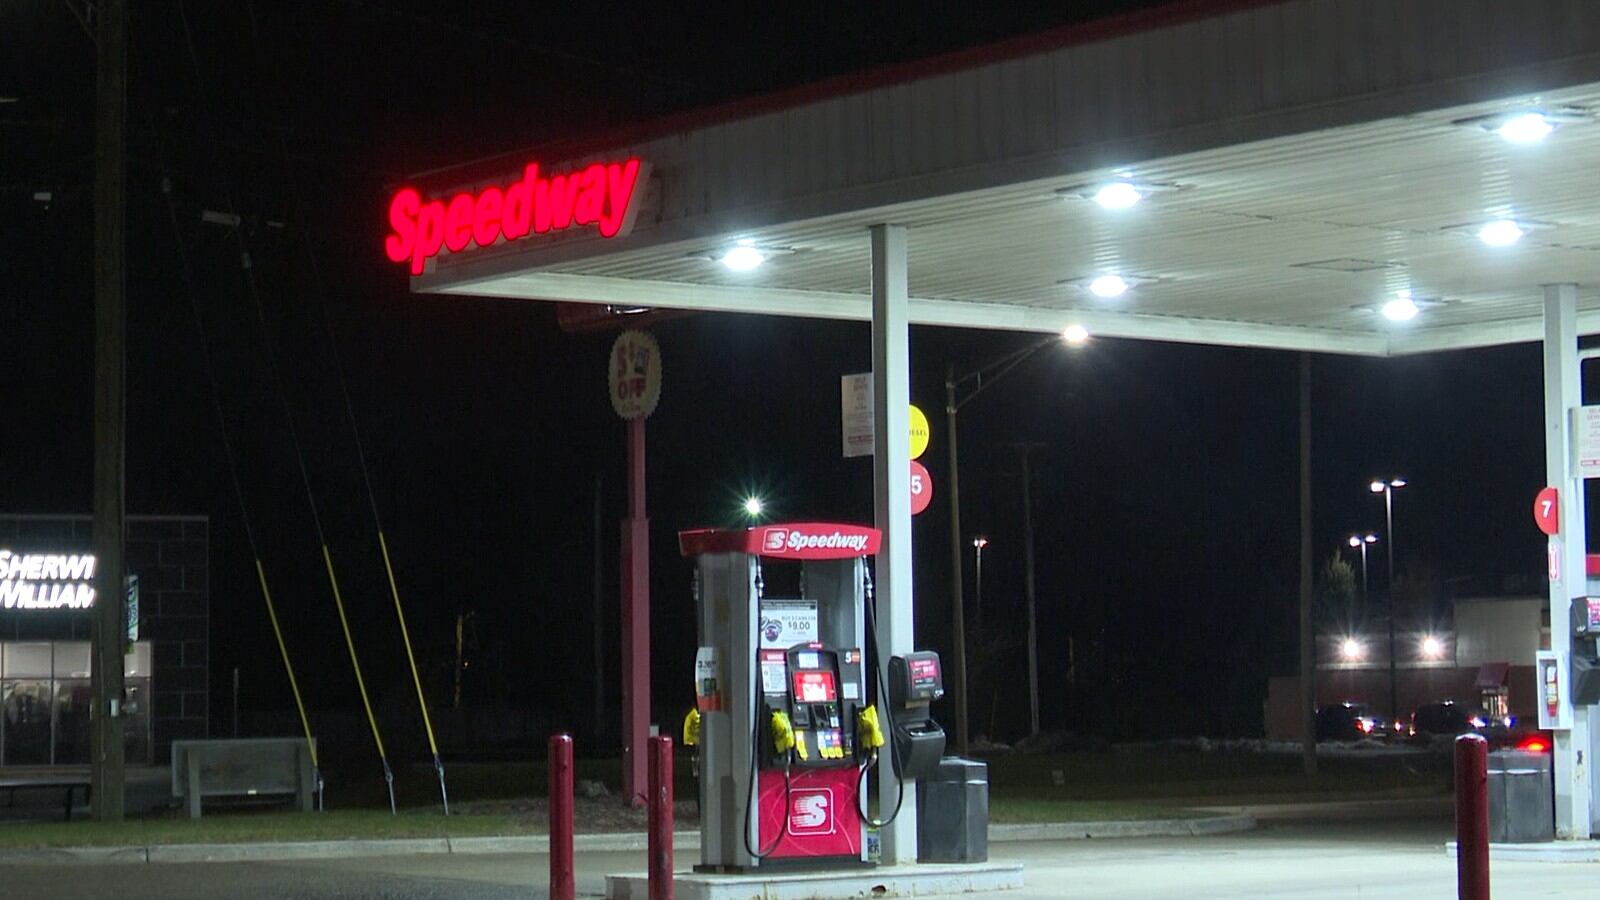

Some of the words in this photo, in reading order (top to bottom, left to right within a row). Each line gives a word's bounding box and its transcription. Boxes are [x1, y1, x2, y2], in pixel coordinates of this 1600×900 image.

[385, 158, 641, 276] Speedway
[911, 475, 922, 495] 5
[1541, 501, 1552, 518] 7
[787, 531, 868, 552] Speedway
[0, 549, 96, 580] SHERWI
[0, 579, 96, 609] WILLIAM
[788, 621, 810, 630] $9.00
